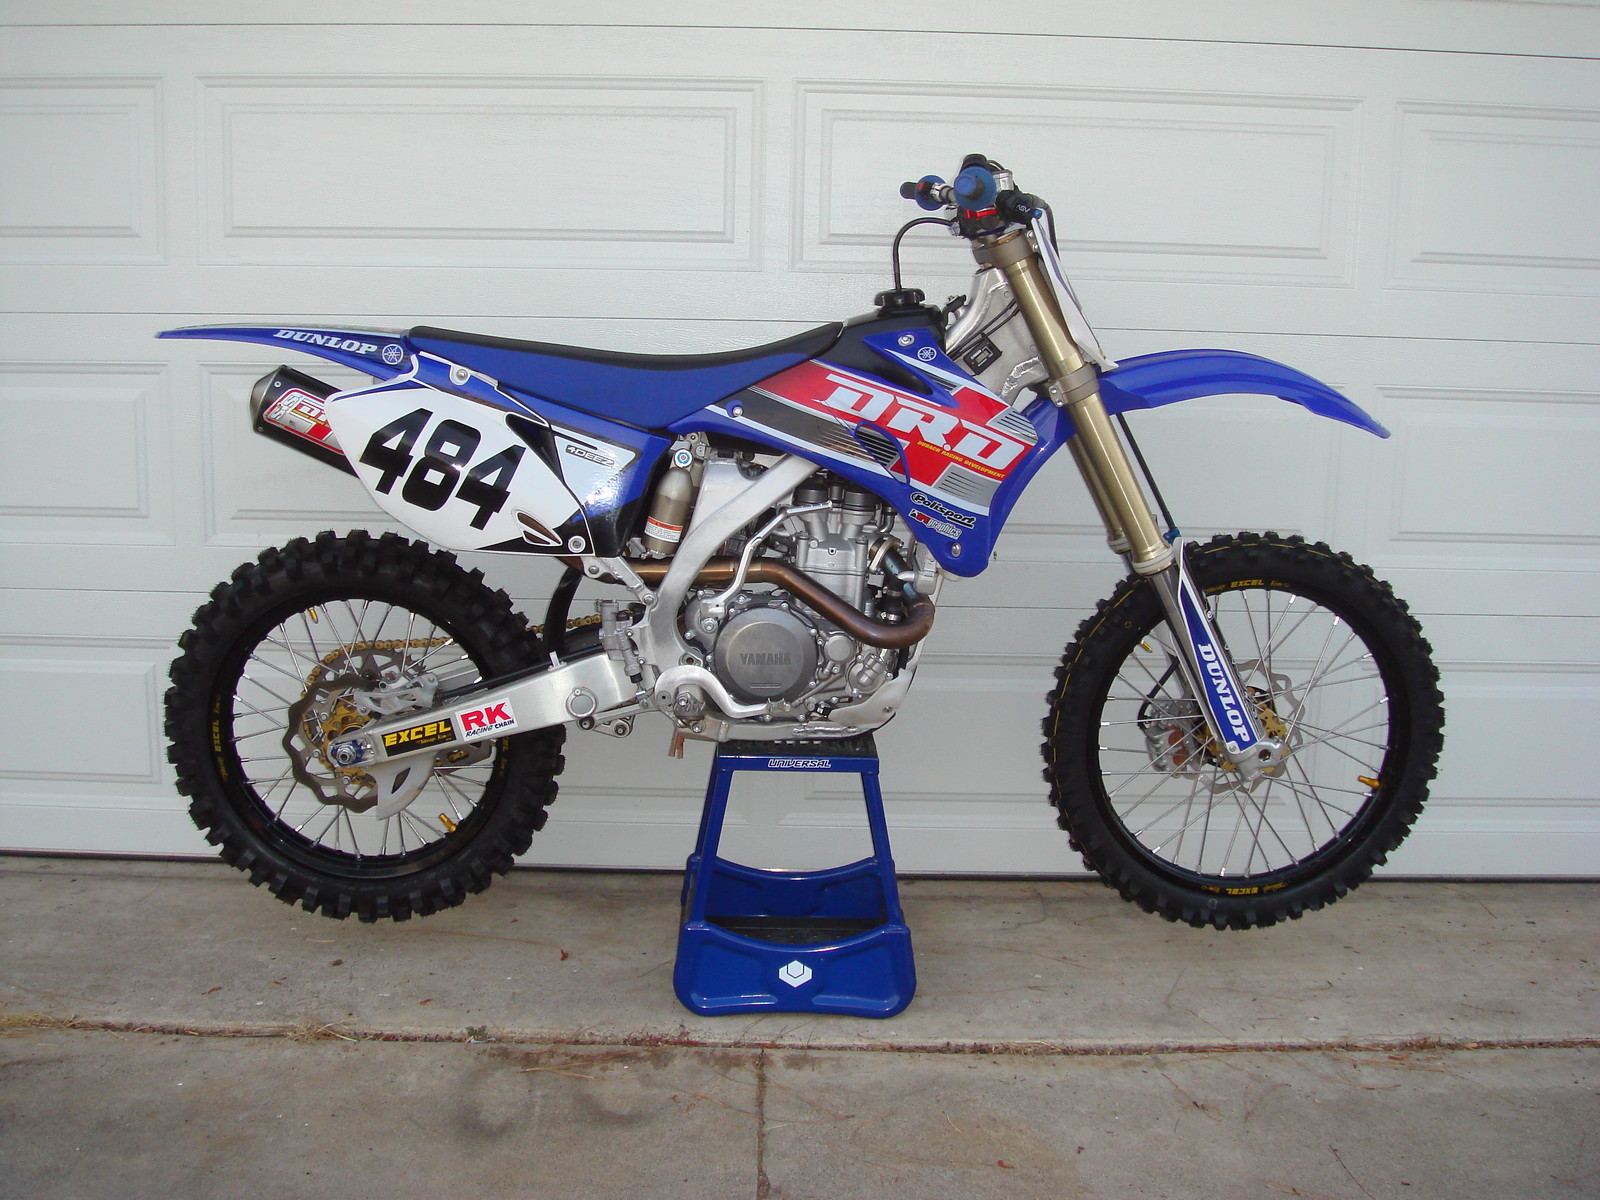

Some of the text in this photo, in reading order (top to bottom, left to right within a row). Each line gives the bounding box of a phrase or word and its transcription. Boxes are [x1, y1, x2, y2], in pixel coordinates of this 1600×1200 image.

[273, 329, 378, 355] DUNLOP
[359, 407, 527, 531] 484
[941, 450, 963, 462] RACING
[964, 459, 1006, 479] DEVELOPMENT
[911, 493, 976, 526] Polisport
[1230, 579, 1265, 588] EXCEL
[739, 653, 792, 666] YAMAHA
[1198, 643, 1250, 743] DUNLOP
[460, 702, 512, 732] RK
[465, 719, 515, 738] RACING CHAIN
[384, 721, 451, 747] EXCEL
[767, 758, 832, 769] UNIVERSAL
